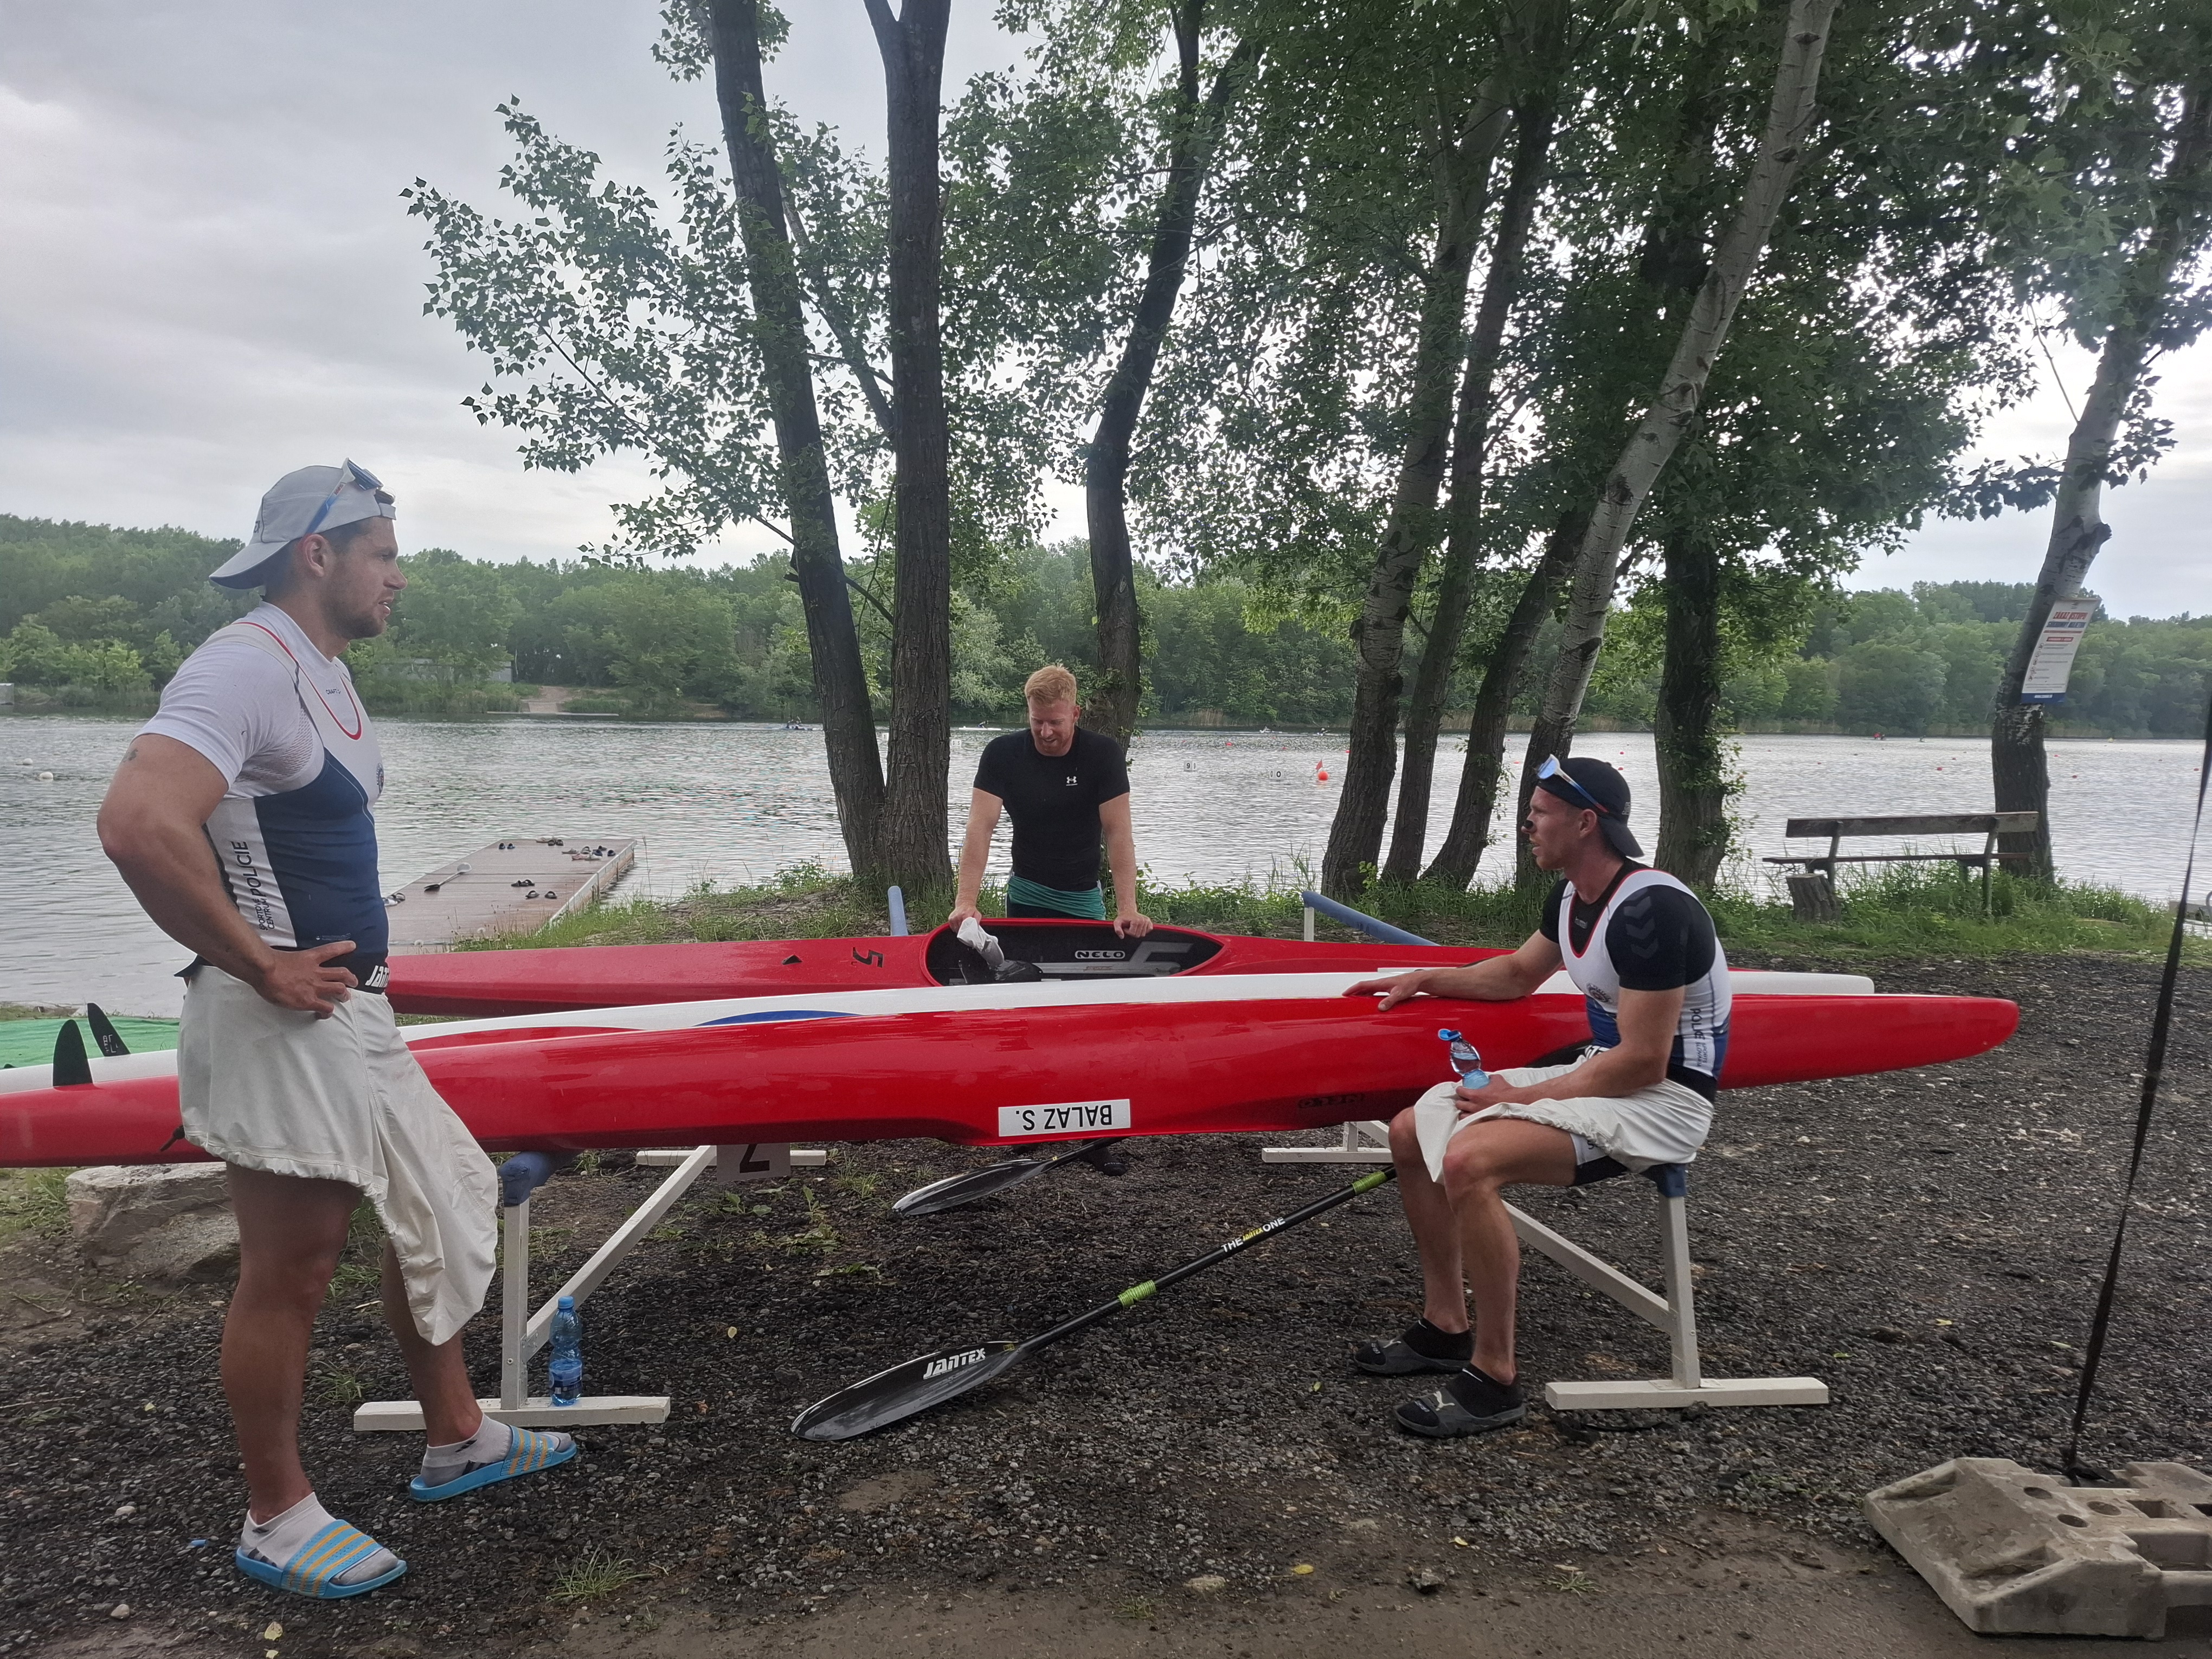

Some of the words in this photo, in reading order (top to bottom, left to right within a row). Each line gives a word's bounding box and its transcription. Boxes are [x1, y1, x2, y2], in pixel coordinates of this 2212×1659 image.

[260, 897, 275, 929] CENTRUM
[1015, 1109, 1036, 1131] S.
[1044, 1104, 1113, 1130] BALAZ
[1220, 1237, 1244, 1252] THE
[1262, 1217, 1286, 1232] ONE
[923, 1347, 986, 1380] JANTEX
